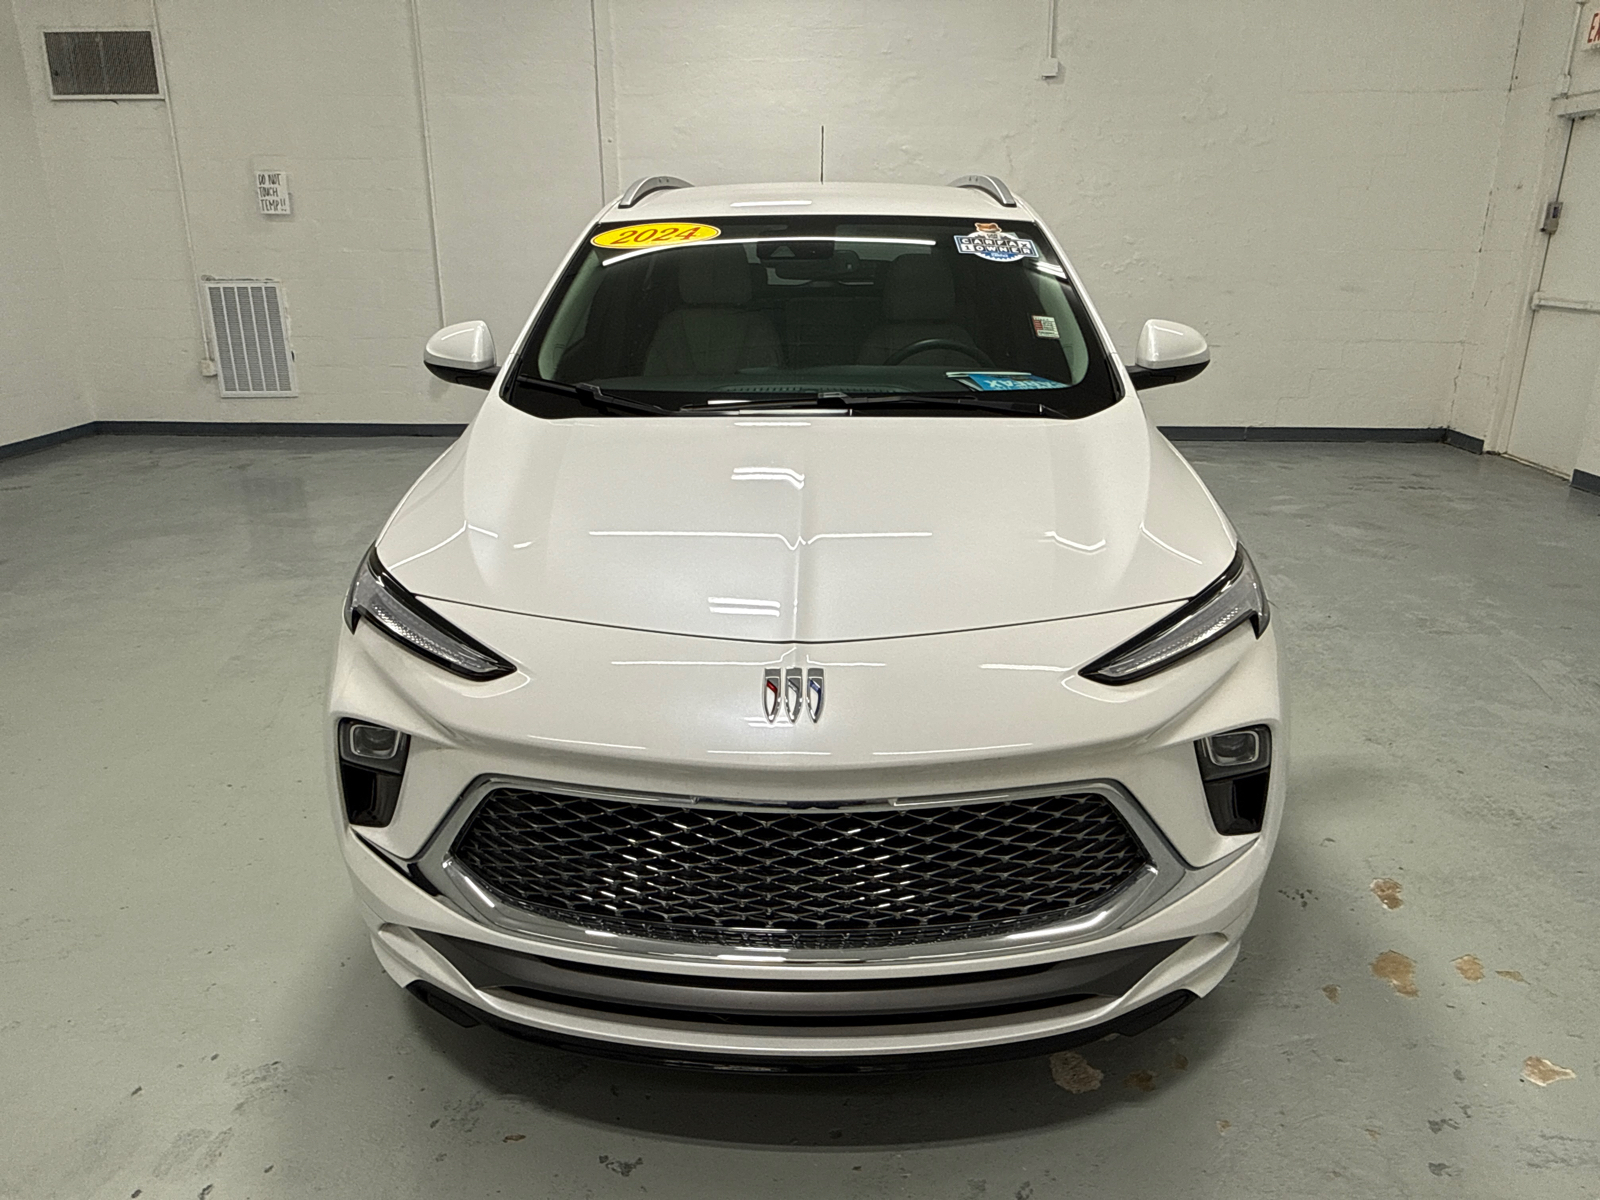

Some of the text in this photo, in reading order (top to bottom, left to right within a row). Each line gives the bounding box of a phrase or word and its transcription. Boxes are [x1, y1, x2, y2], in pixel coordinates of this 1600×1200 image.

[258, 173, 281, 186] DO NOT
[259, 186, 278, 198] TOUCH
[610, 226, 701, 245] 2024
[961, 239, 1030, 248] CARFAX
[976, 246, 1031, 254] OWNER
